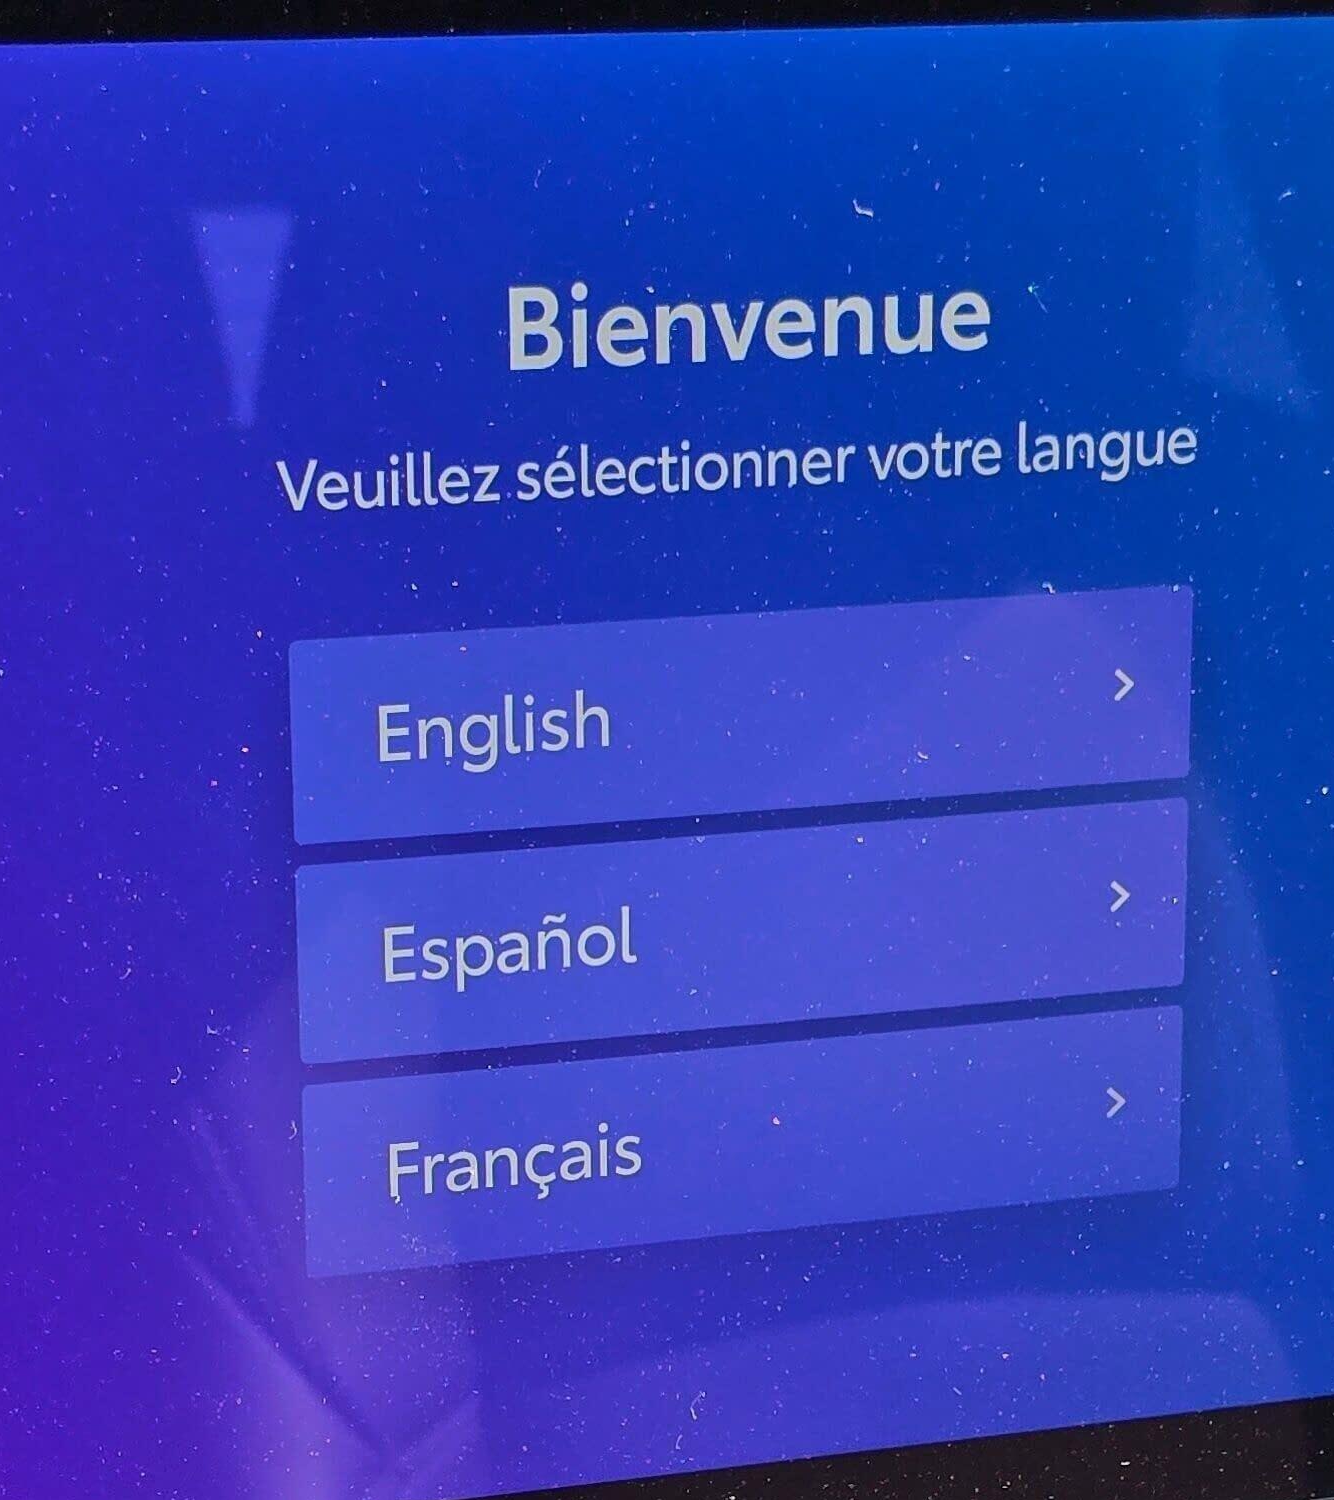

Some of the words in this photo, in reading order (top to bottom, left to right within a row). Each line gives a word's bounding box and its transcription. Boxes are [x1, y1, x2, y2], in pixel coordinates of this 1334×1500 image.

[507, 281, 991, 372] Bienvenue
[277, 451, 500, 513] Veuillez
[516, 437, 851, 502] sélectionner
[868, 428, 1001, 484] votre
[1017, 420, 1198, 484] langue
[377, 689, 612, 773] English
[382, 906, 638, 992] Español
[387, 1124, 643, 1204] Français
